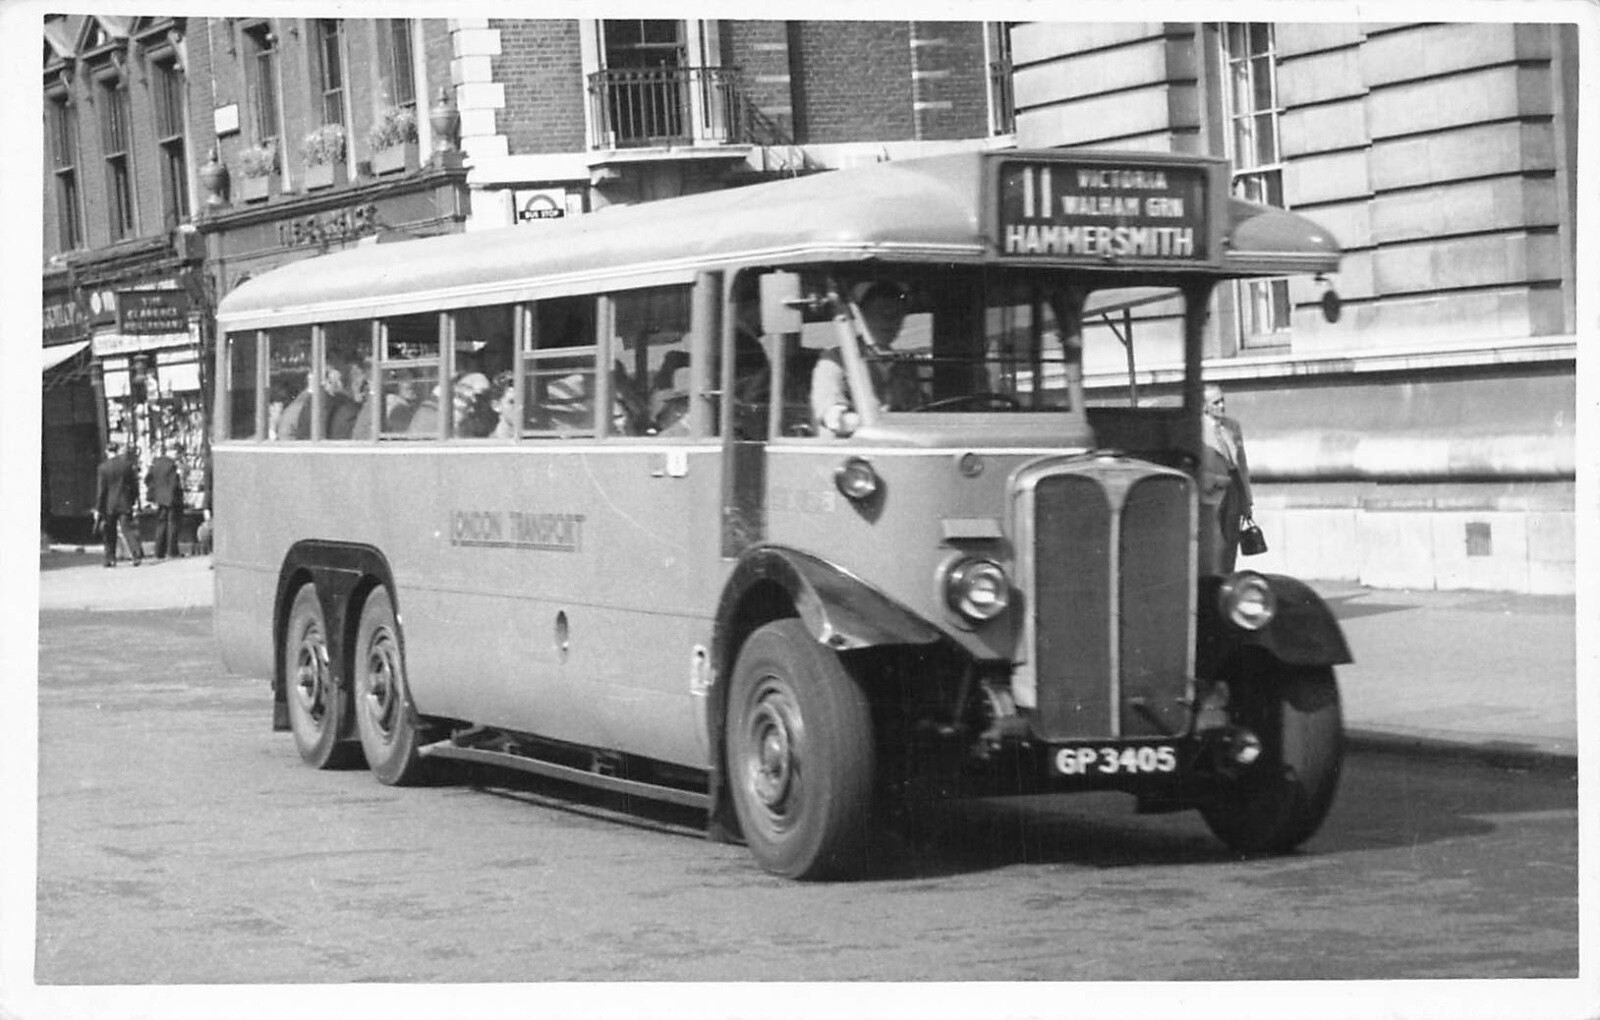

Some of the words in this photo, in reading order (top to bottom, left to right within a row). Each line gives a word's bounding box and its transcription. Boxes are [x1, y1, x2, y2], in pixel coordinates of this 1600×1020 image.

[1022, 166, 1052, 218] 11
[1076, 169, 1168, 189] VICTORIA
[541, 210, 558, 218] STOP
[1061, 195, 1140, 216] WALHAM
[1006, 225, 1194, 256] HAMMERSMITH
[449, 510, 502, 544] LONDON
[509, 511, 586, 550] TRANSPORT
